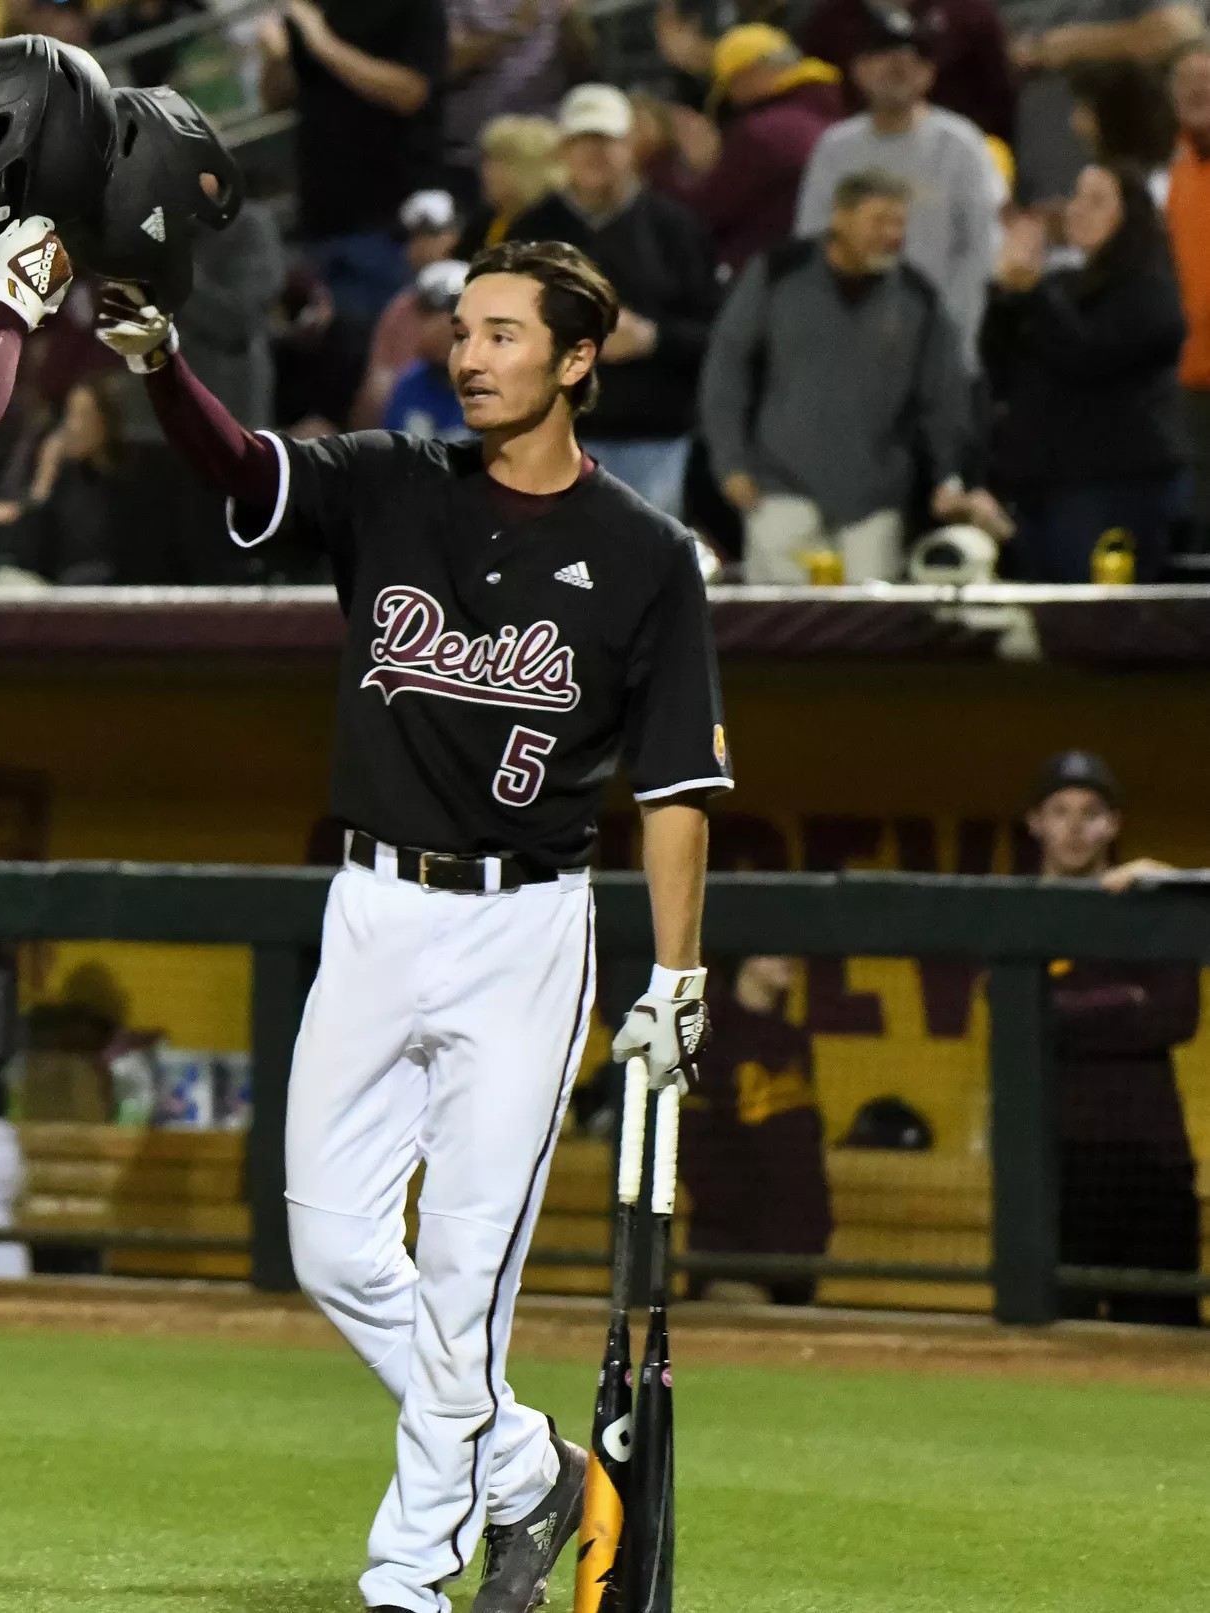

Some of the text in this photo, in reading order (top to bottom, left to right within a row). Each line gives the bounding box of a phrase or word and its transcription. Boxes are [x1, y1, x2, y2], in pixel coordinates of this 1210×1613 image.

[38, 241, 57, 294] adidas
[370, 585, 581, 698] Devils
[492, 724, 557, 807] 5
